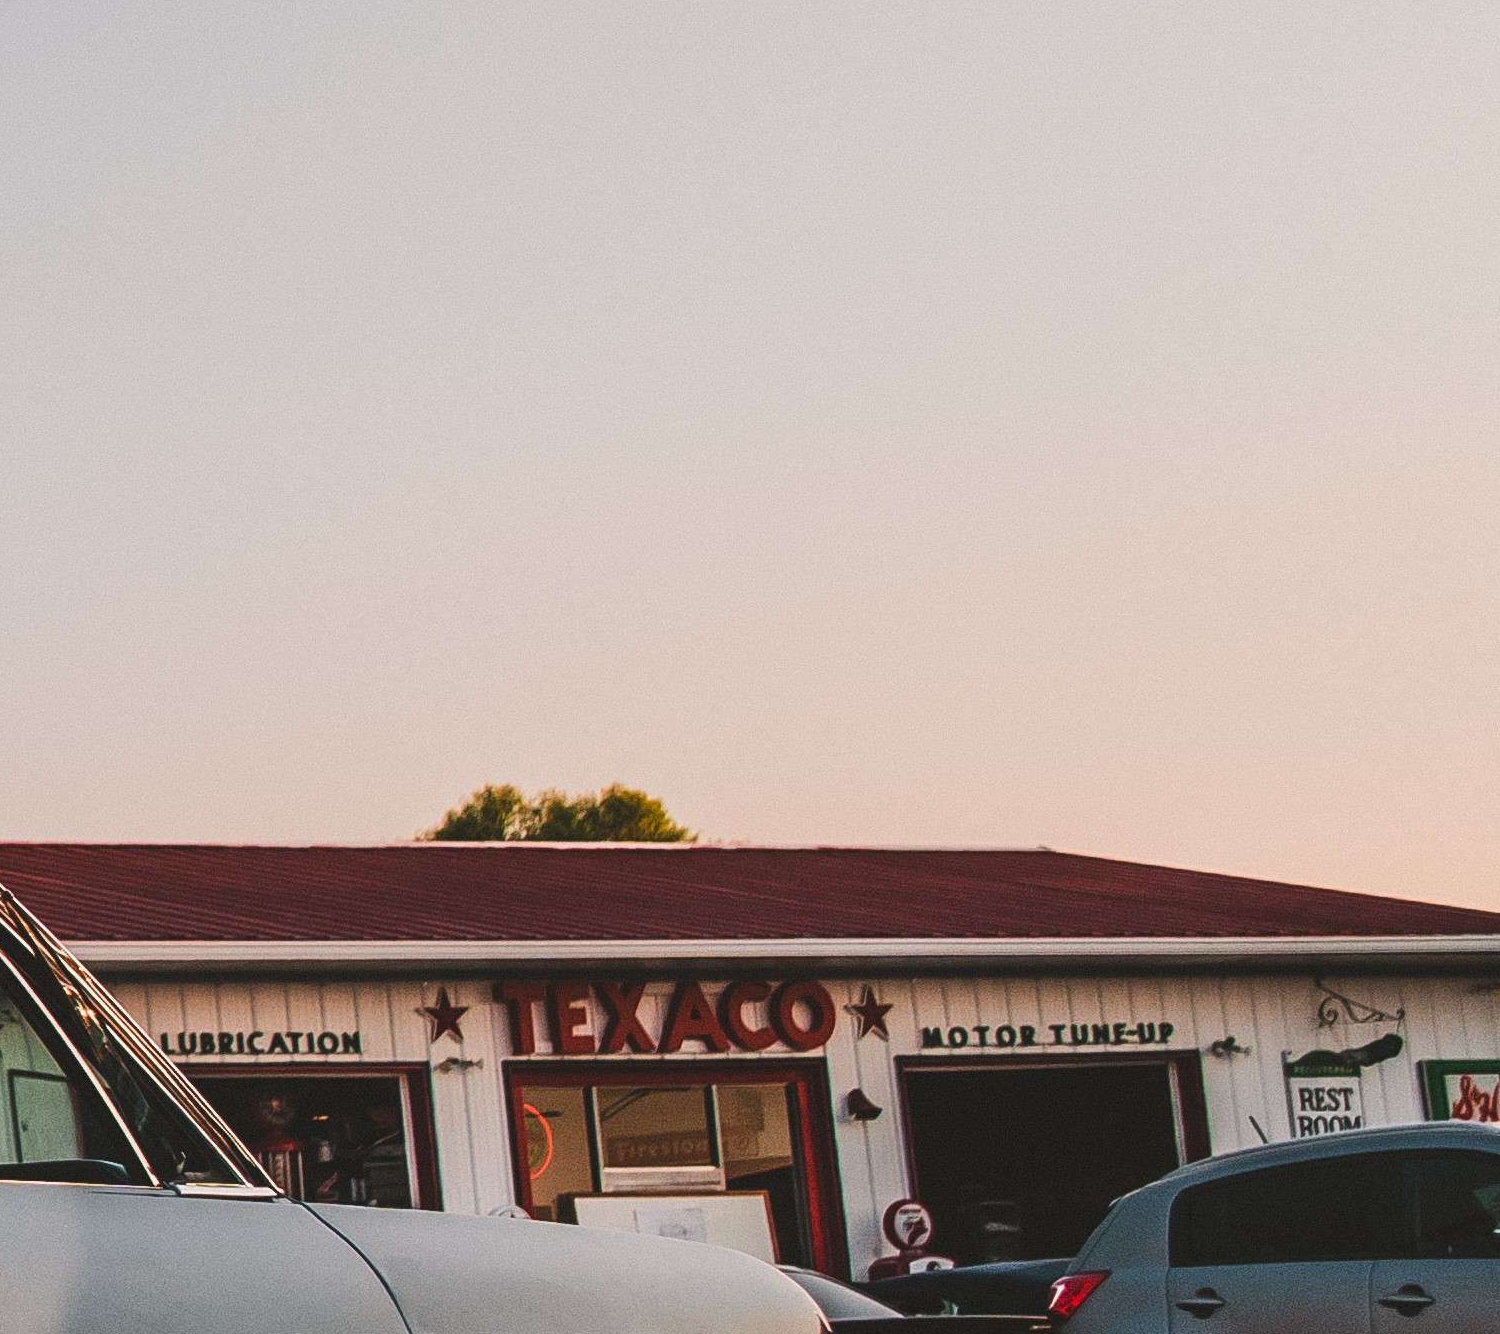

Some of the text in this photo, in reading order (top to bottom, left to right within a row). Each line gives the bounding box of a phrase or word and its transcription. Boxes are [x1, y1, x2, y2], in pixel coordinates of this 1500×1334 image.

[498, 980, 836, 1055] TEXACO
[160, 1031, 362, 1055] LUBRICATION
[921, 1022, 1175, 1048] MOTOR TUNE-UP
[1300, 1087, 1354, 1113] REST
